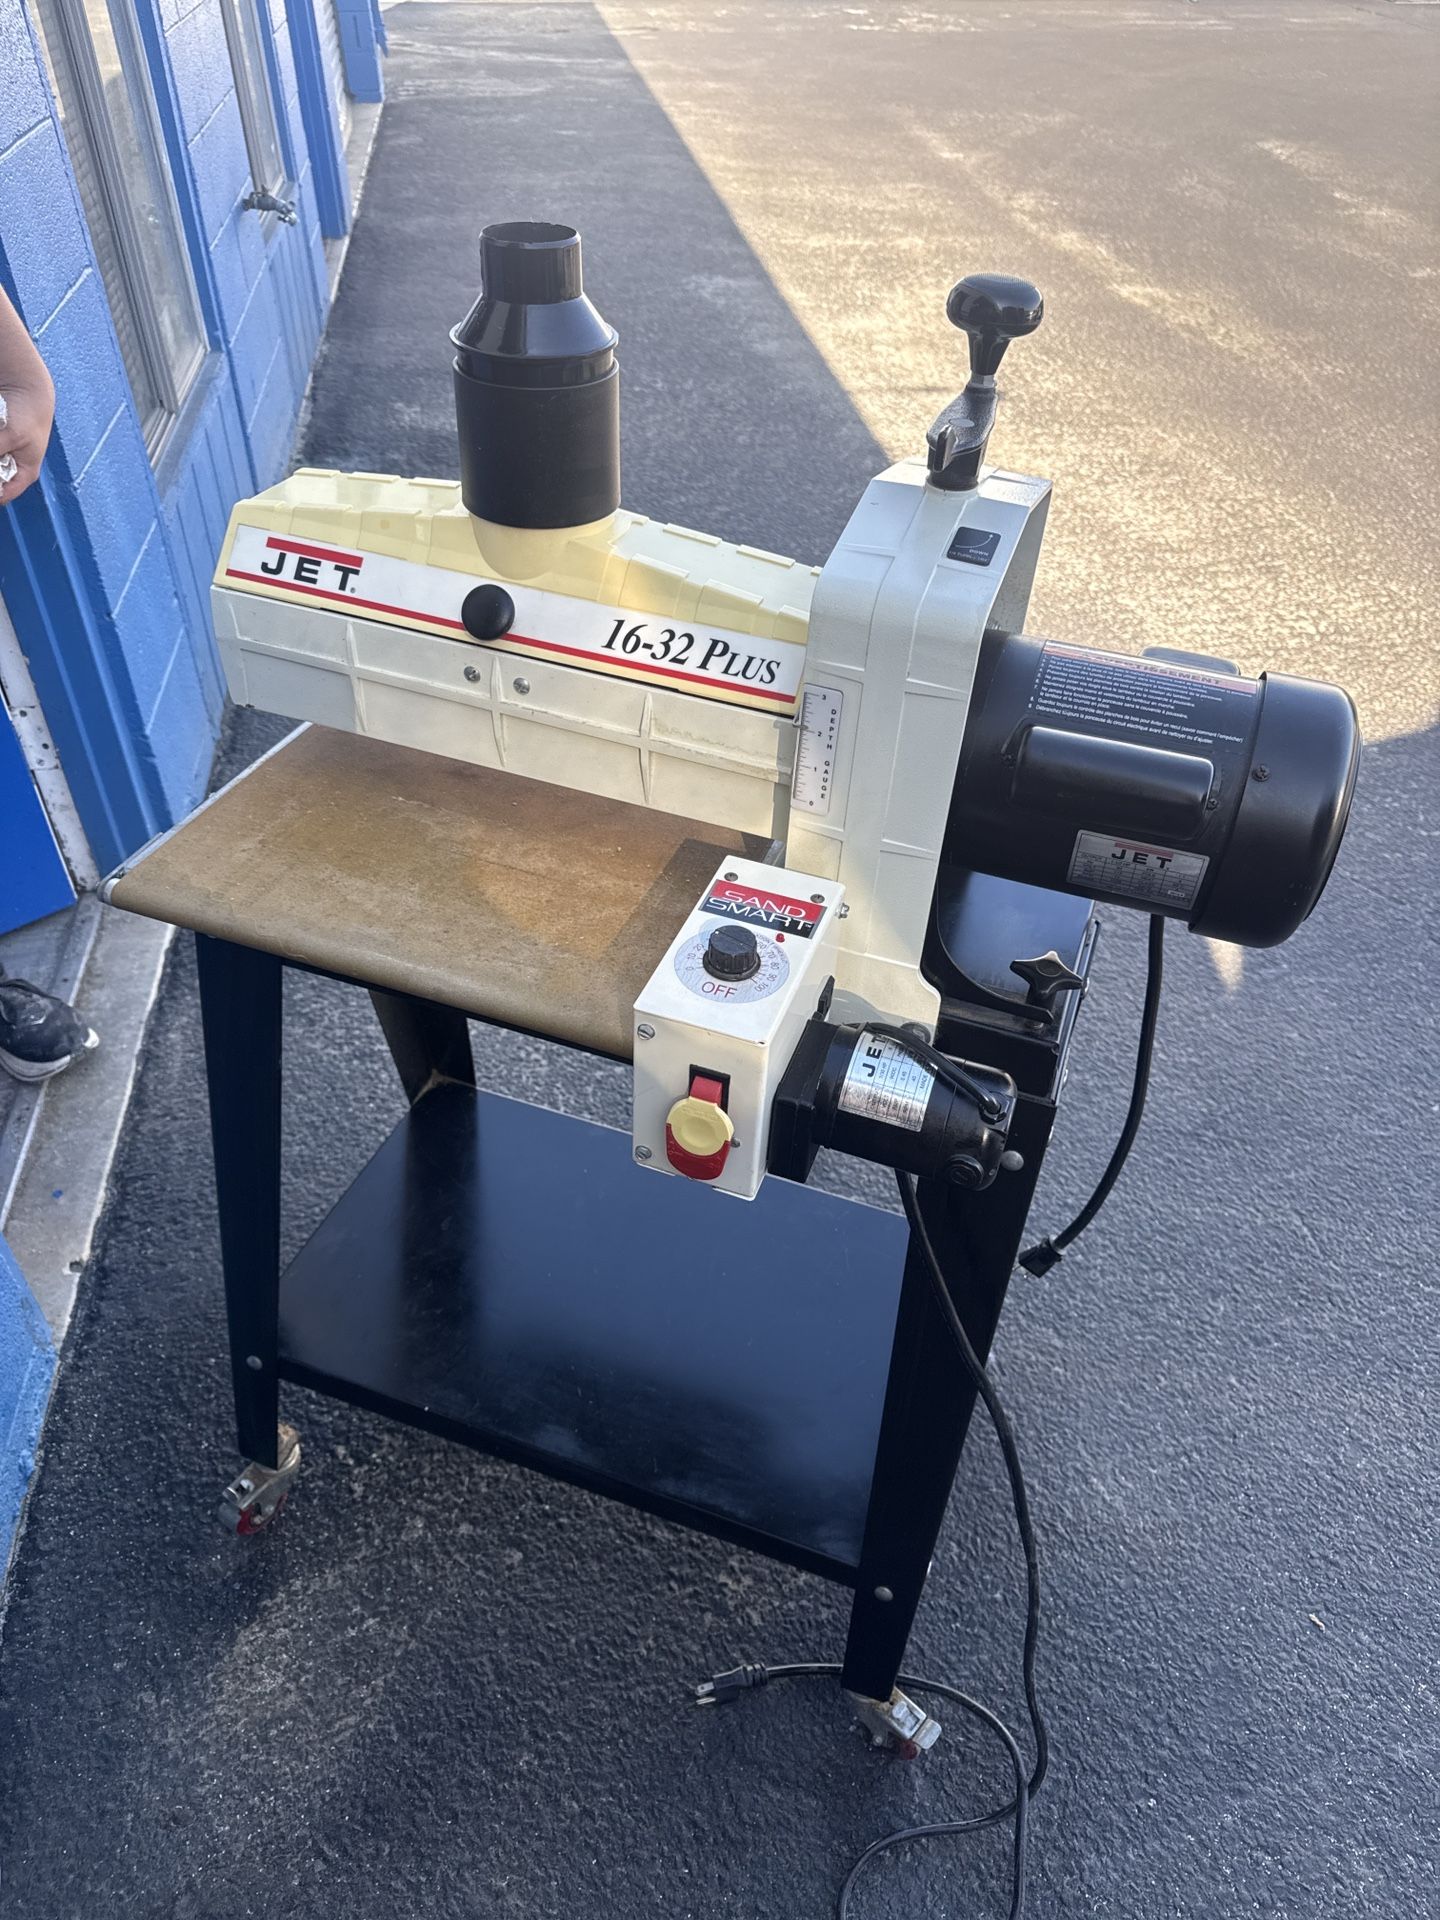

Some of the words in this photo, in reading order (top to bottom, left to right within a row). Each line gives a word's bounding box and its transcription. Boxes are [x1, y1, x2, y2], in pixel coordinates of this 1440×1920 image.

[601, 619, 694, 665] 16-32
[697, 638, 781, 684] PLUS
[826, 709, 836, 749] DEPTH
[820, 760, 830, 799] GAUGE
[722, 890, 806, 918] SAND
[701, 981, 738, 999] OFF
